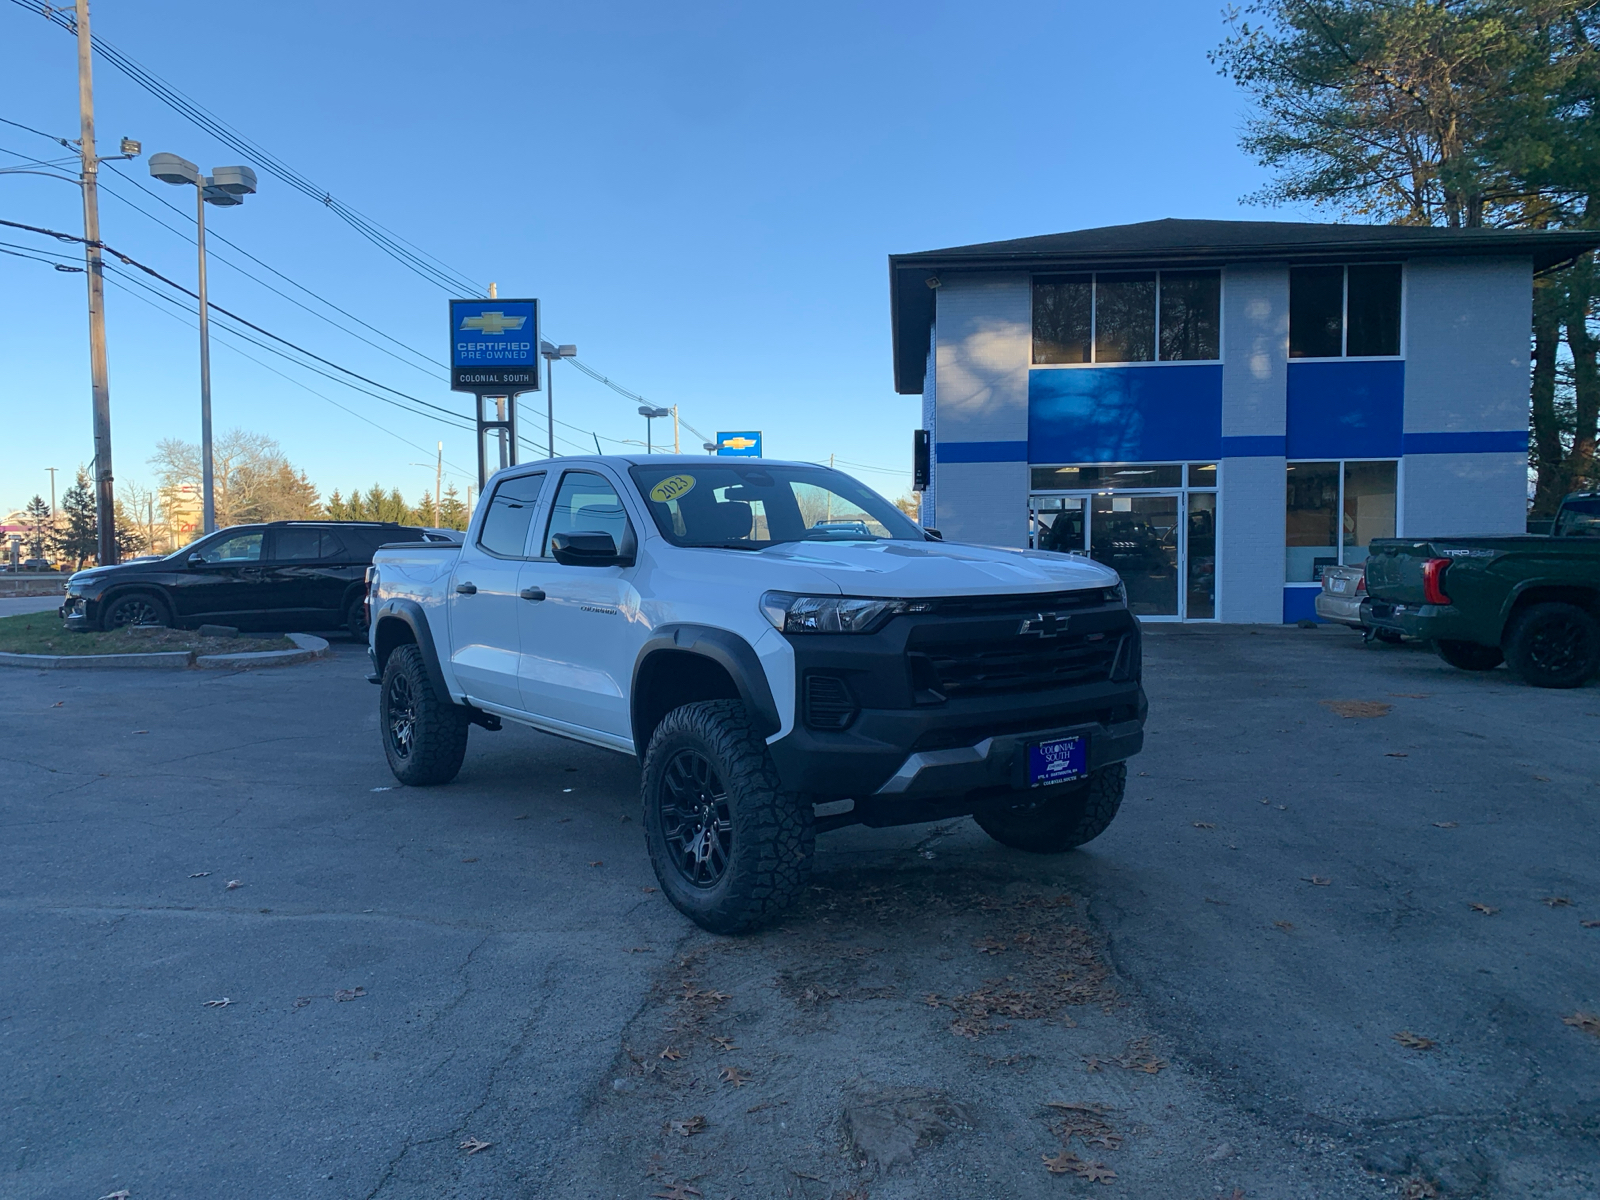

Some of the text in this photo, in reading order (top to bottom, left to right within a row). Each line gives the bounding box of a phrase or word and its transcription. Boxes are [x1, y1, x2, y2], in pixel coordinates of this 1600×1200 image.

[457, 342, 531, 351] CERTIFIED
[461, 351, 527, 359] PRE-OWNED
[460, 374, 529, 382] COLONIAL SOUTH
[657, 476, 689, 500] 2023
[1443, 549, 1470, 557] TRD
[1040, 742, 1075, 755] COLONIAL
[1045, 751, 1070, 762] SOUTH
